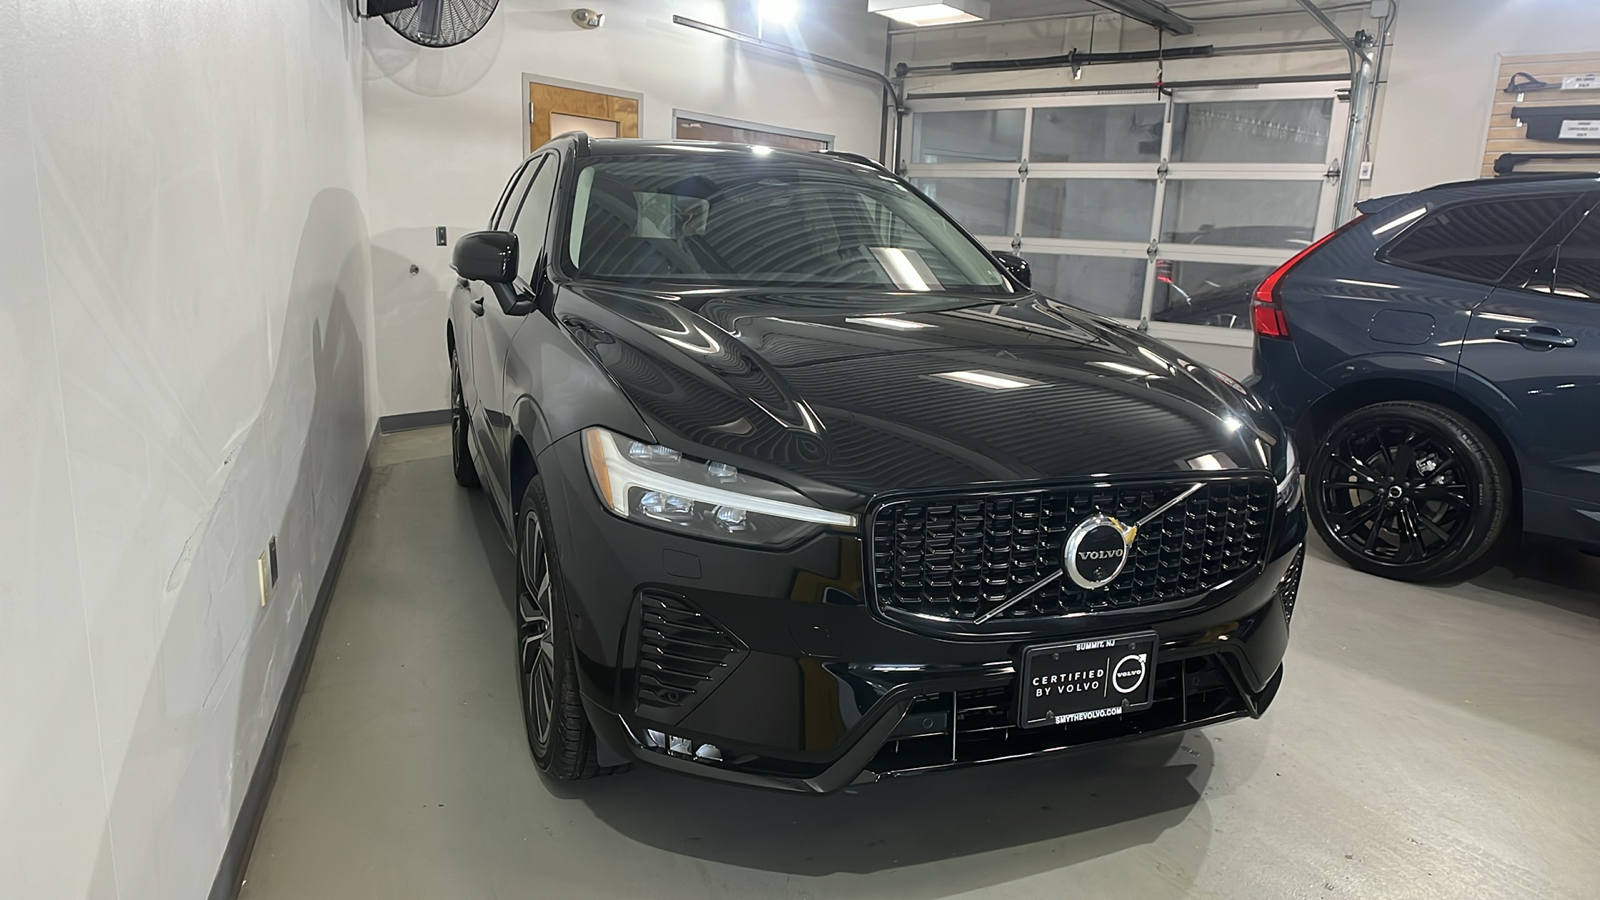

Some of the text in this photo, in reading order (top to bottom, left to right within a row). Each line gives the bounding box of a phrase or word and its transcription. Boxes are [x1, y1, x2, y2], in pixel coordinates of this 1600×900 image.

[1079, 549, 1123, 560] VOLVO
[1106, 639, 1116, 647] NJ
[1032, 669, 1104, 686] CERTIFIED
[1117, 669, 1142, 678] VOLVO
[1036, 681, 1099, 697] BY VOLVO
[1055, 706, 1122, 724] SMYTHEVOLVO.COM
